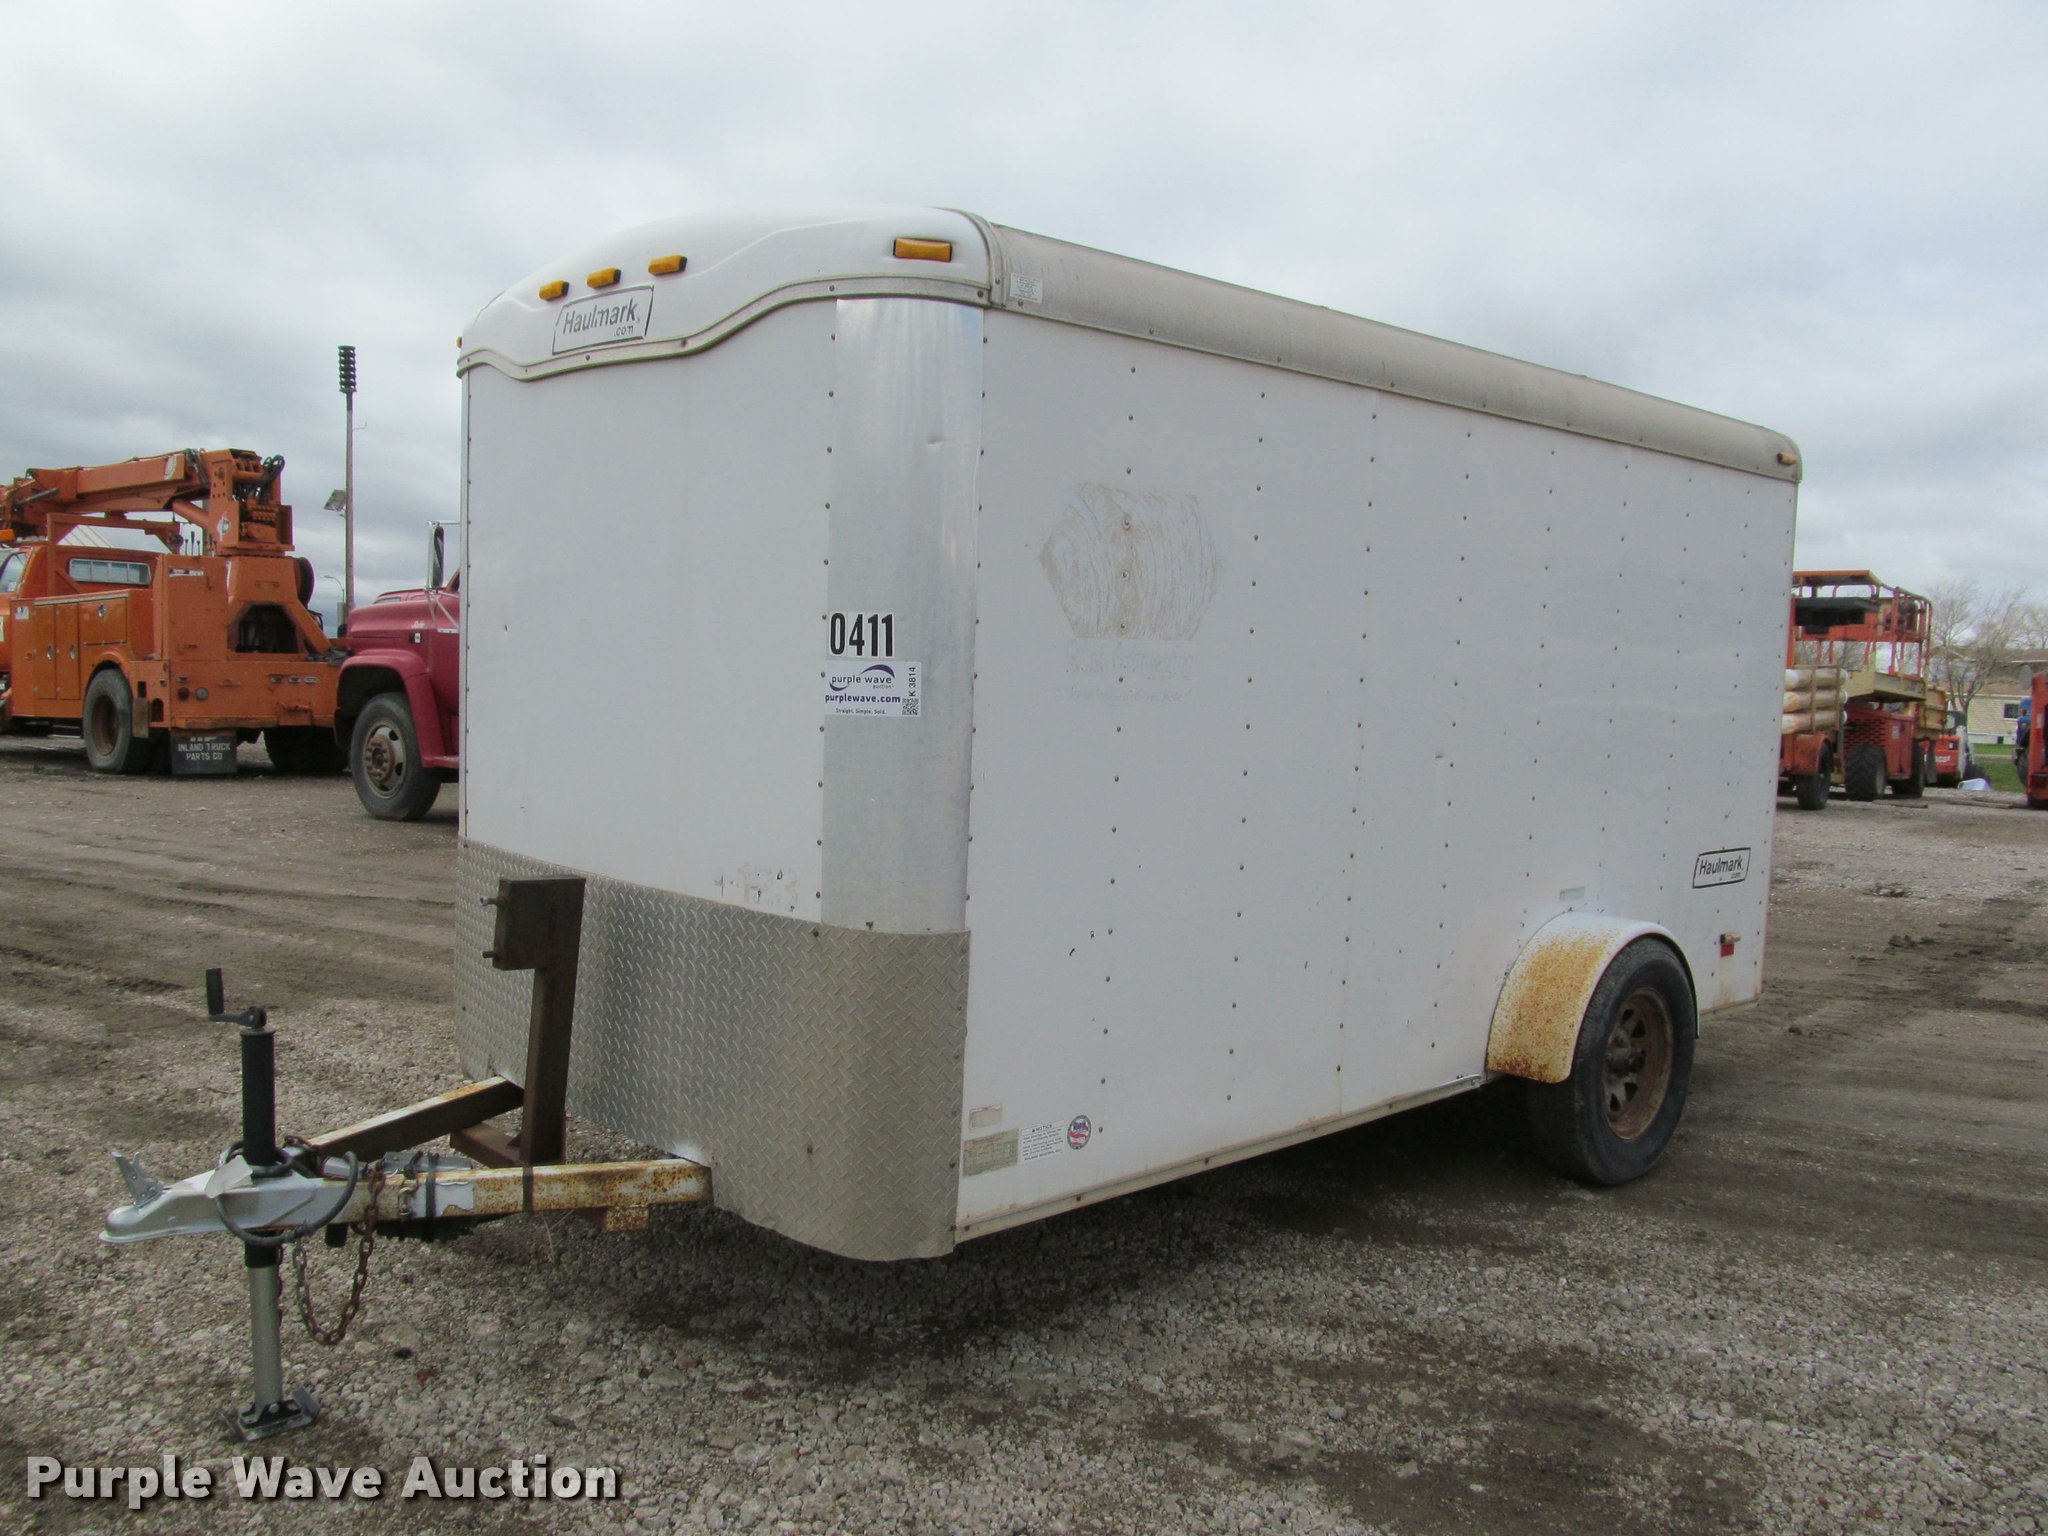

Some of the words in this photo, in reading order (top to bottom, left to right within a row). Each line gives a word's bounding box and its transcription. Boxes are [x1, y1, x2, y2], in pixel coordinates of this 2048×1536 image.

[563, 297, 638, 335] Haulmark
[830, 612, 893, 657] 0411
[832, 675, 861, 684] purple
[825, 693, 901, 704] purplewave.com
[178, 743, 204, 751] INLAND
[205, 743, 231, 751] TRUCK
[186, 752, 211, 760] PARTS
[213, 752, 223, 760] CO
[1699, 855, 1744, 875] Haulmark
